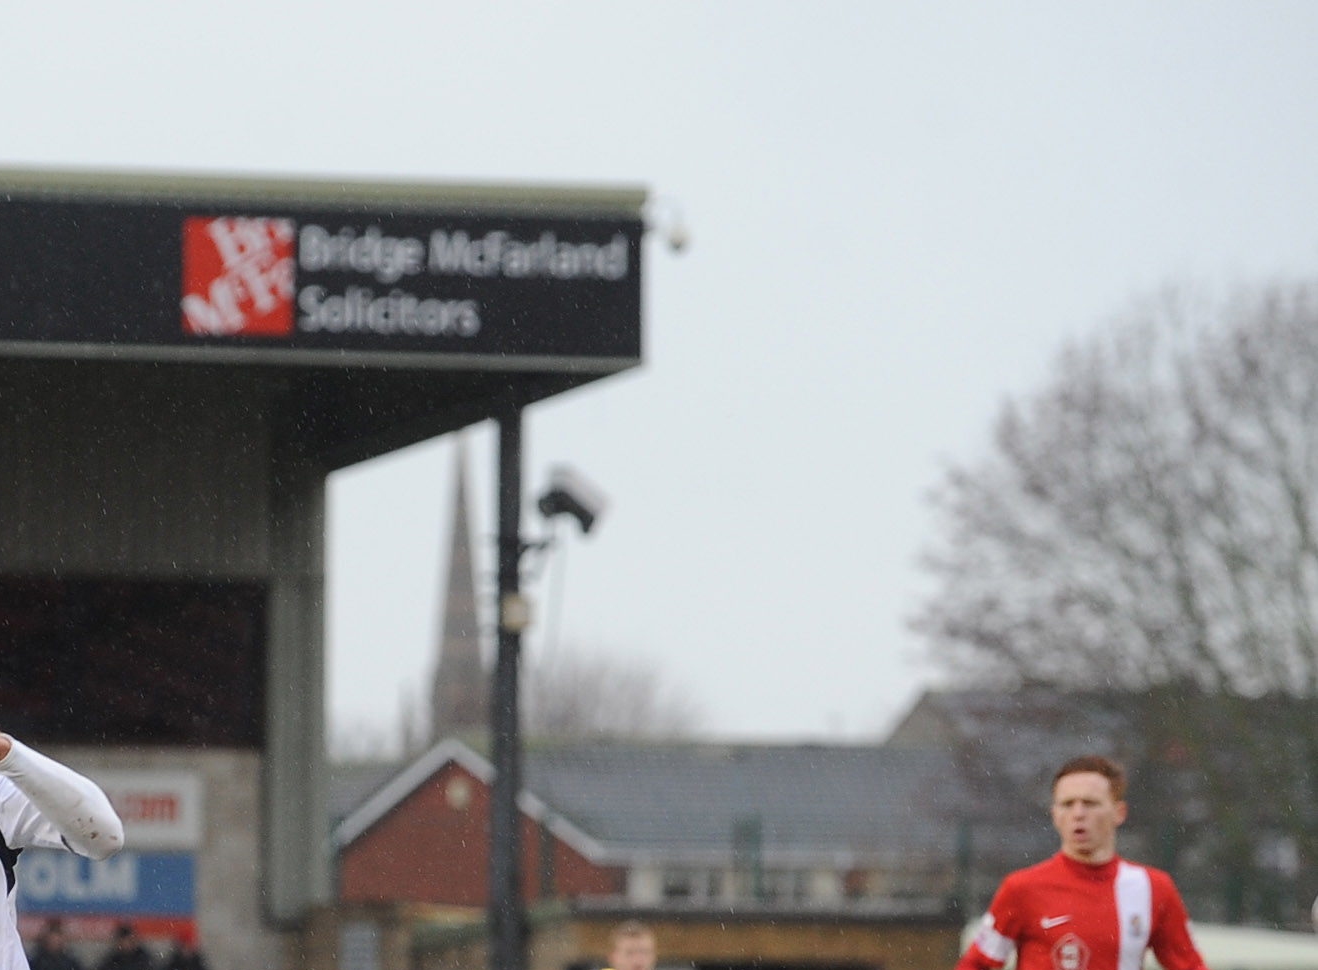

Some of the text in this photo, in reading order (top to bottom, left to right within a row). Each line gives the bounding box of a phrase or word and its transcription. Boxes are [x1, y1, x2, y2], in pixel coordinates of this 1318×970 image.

[299, 224, 424, 283] Bridge
[429, 229, 629, 281] McFarland
[297, 285, 480, 336] Solicitors
